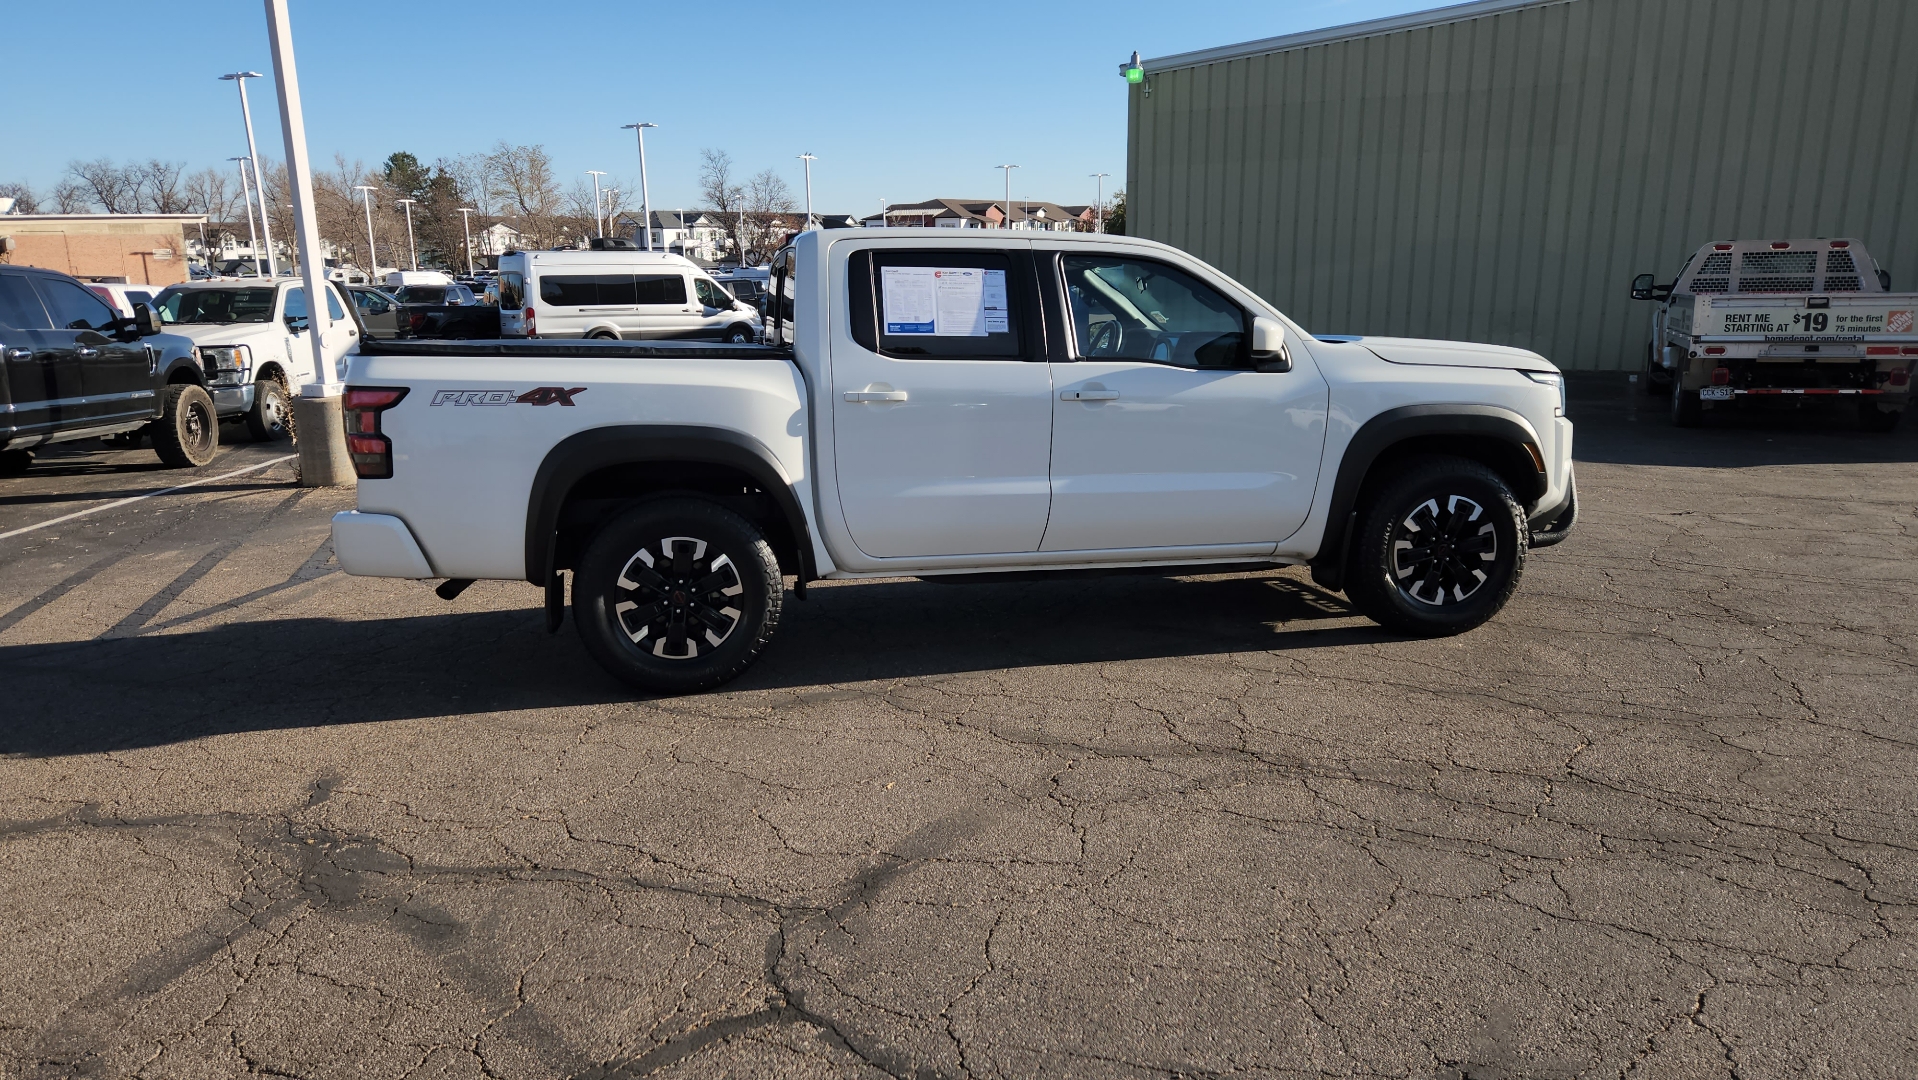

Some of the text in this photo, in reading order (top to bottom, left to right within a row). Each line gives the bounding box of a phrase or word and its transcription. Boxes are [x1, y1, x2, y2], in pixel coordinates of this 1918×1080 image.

[1725, 313, 1771, 323] RENT ME
[1793, 312, 1828, 332] $19
[1836, 314, 1883, 323] for the first
[1887, 310, 1915, 333] HOME
[1723, 323, 1790, 333] STARTING AT
[430, 386, 588, 407] PRO-4X
